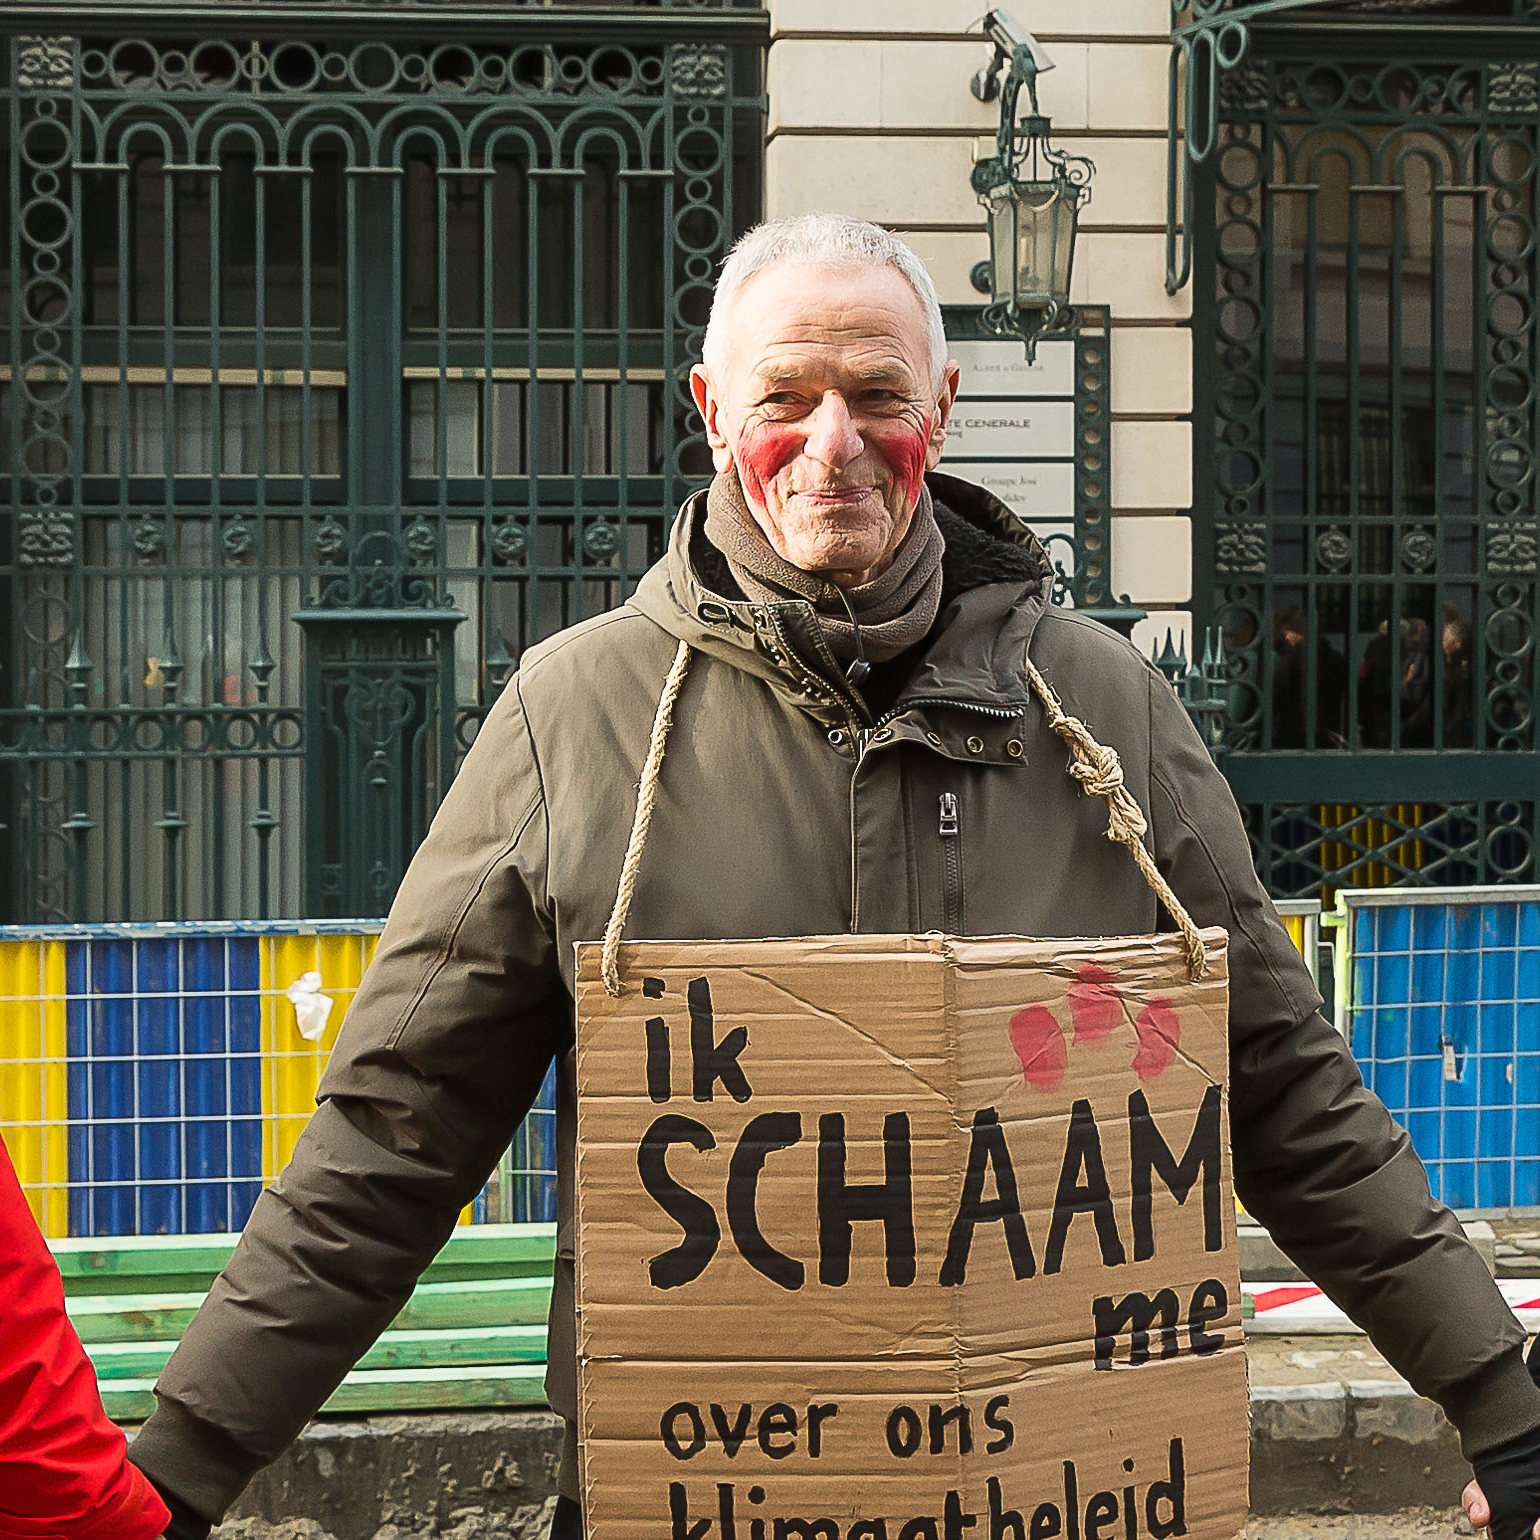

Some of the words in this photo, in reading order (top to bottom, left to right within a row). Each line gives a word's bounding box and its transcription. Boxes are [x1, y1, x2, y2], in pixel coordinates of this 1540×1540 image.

[642, 976, 752, 1103] ik
[636, 1084, 1223, 1290] SCHAAM
[1092, 1278, 1228, 1371] me
[660, 1400, 839, 1460] over
[886, 1395, 1015, 1459] ons
